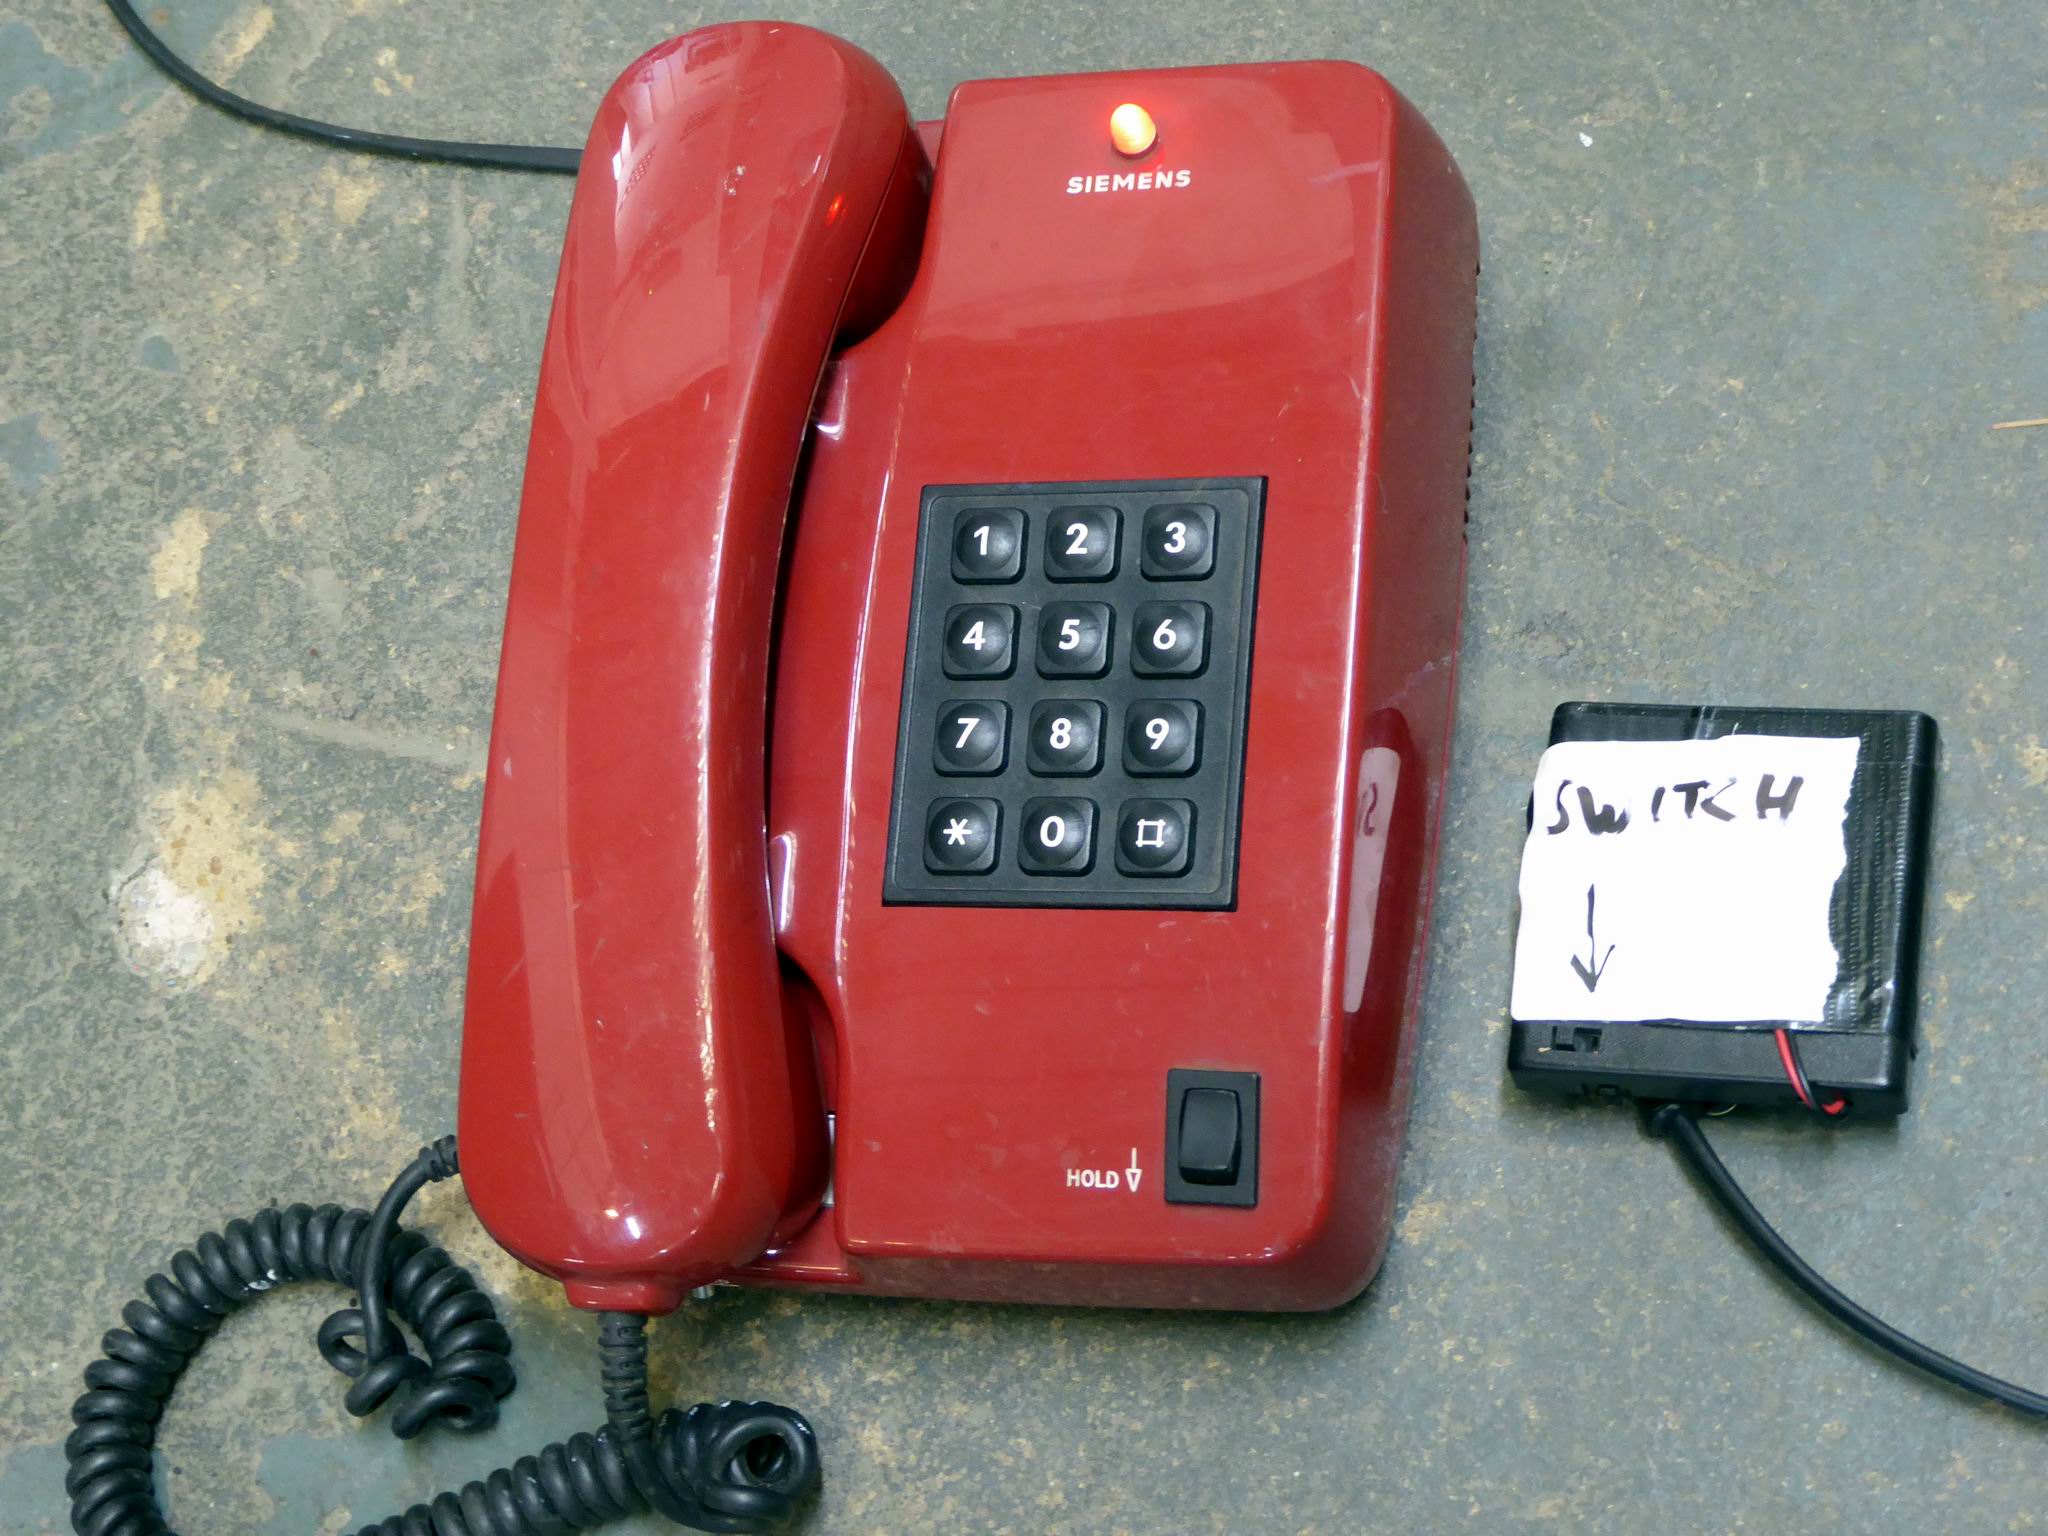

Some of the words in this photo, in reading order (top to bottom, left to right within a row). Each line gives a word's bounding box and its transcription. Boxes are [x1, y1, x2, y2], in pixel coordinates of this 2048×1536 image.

[1066, 169, 1192, 195] SIEMENS
[973, 524, 990, 556] 1
[1065, 522, 1088, 555] 2
[1163, 521, 1187, 553] 3
[962, 620, 986, 651] 4
[1058, 618, 1080, 650] 5
[1152, 618, 1177, 650] 6
[955, 717, 980, 749] 7
[1048, 717, 1072, 750] 8
[1145, 718, 1170, 750] 9
[1546, 773, 1804, 836] SWITCH
[1039, 816, 1065, 848] 0
[1065, 1168, 1120, 1189] HOLD
